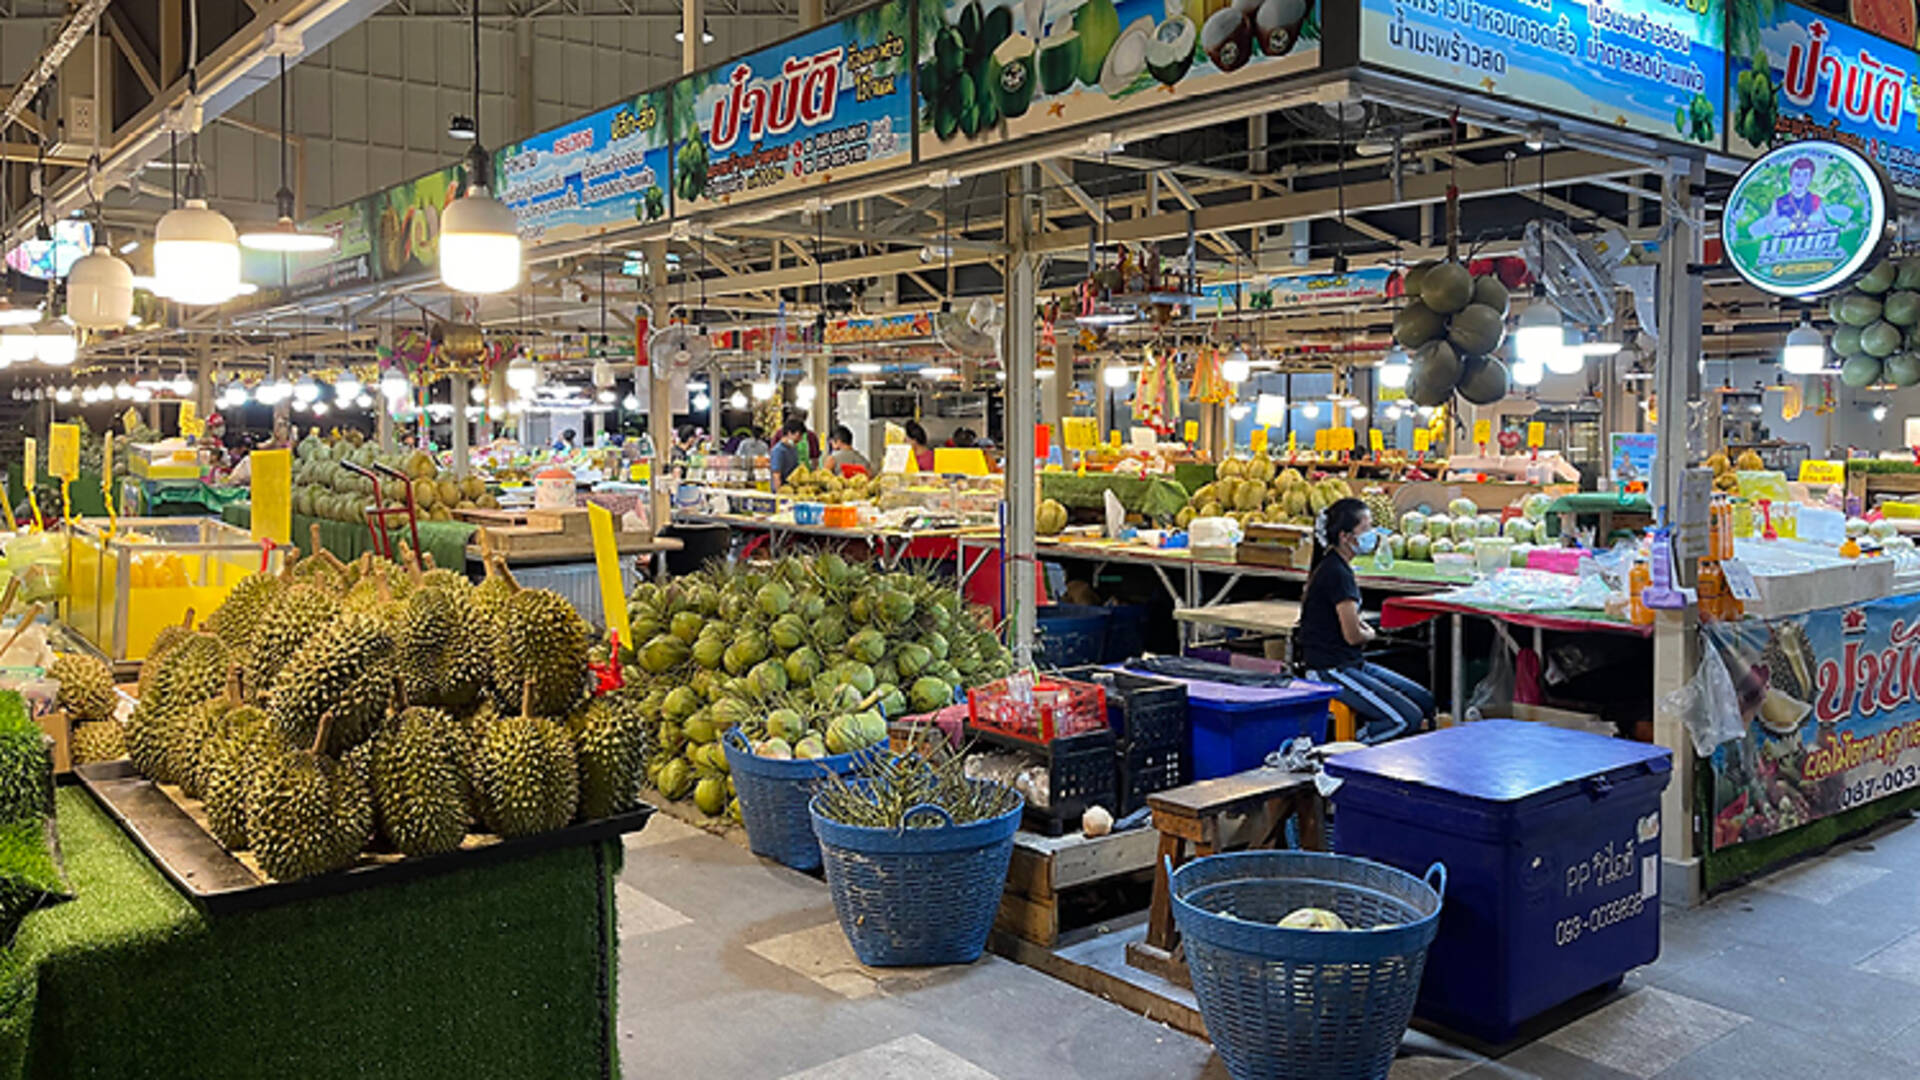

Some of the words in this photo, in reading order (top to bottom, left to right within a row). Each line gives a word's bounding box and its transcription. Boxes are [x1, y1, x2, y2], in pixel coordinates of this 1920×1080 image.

[1388, 6, 1507, 75] น้ำมะพร้าวสด
[1784, 20, 1907, 133] ป๋าบัติ
[710, 46, 843, 151] ป๋าบัติ
[1815, 608, 1920, 722] ป๋าบั
